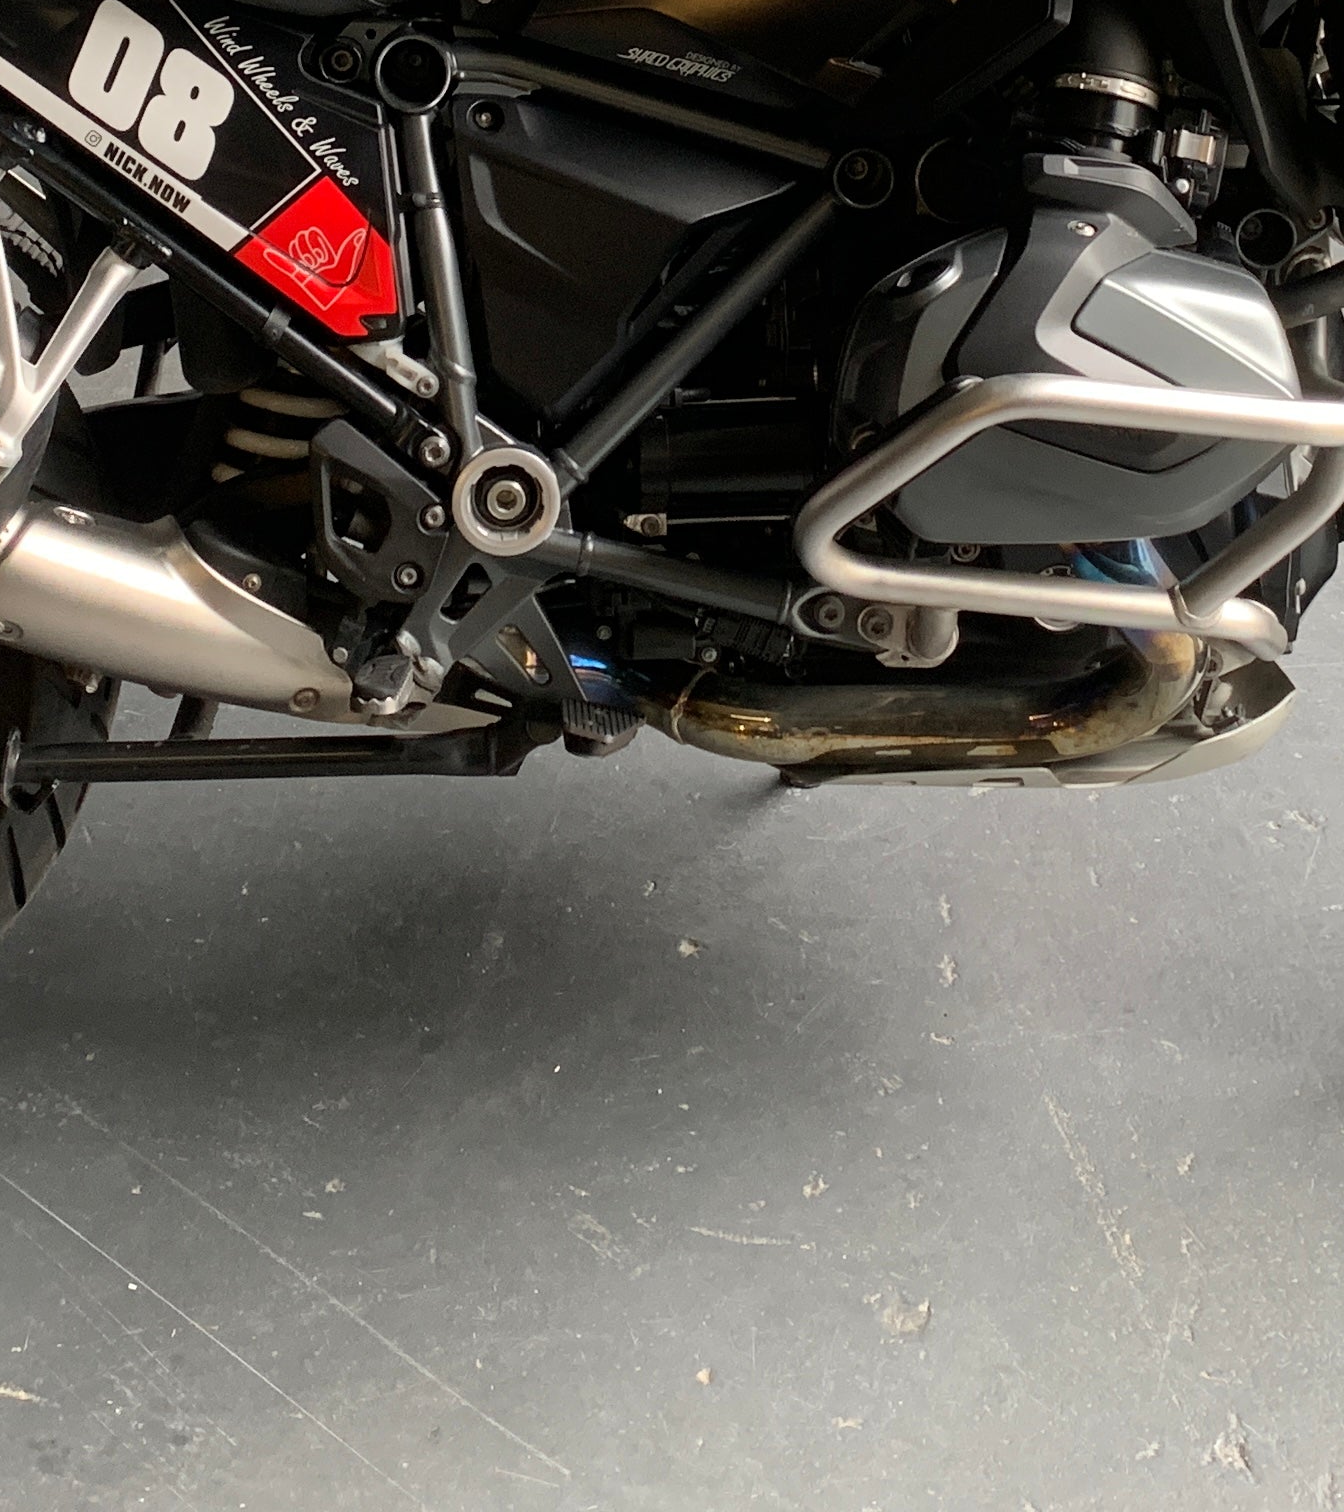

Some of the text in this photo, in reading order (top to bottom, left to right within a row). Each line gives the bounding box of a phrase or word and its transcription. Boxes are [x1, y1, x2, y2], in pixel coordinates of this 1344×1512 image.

[203, 15, 359, 187] Wind Wheels & Waves
[103, 141, 191, 214] NICK.NOW
